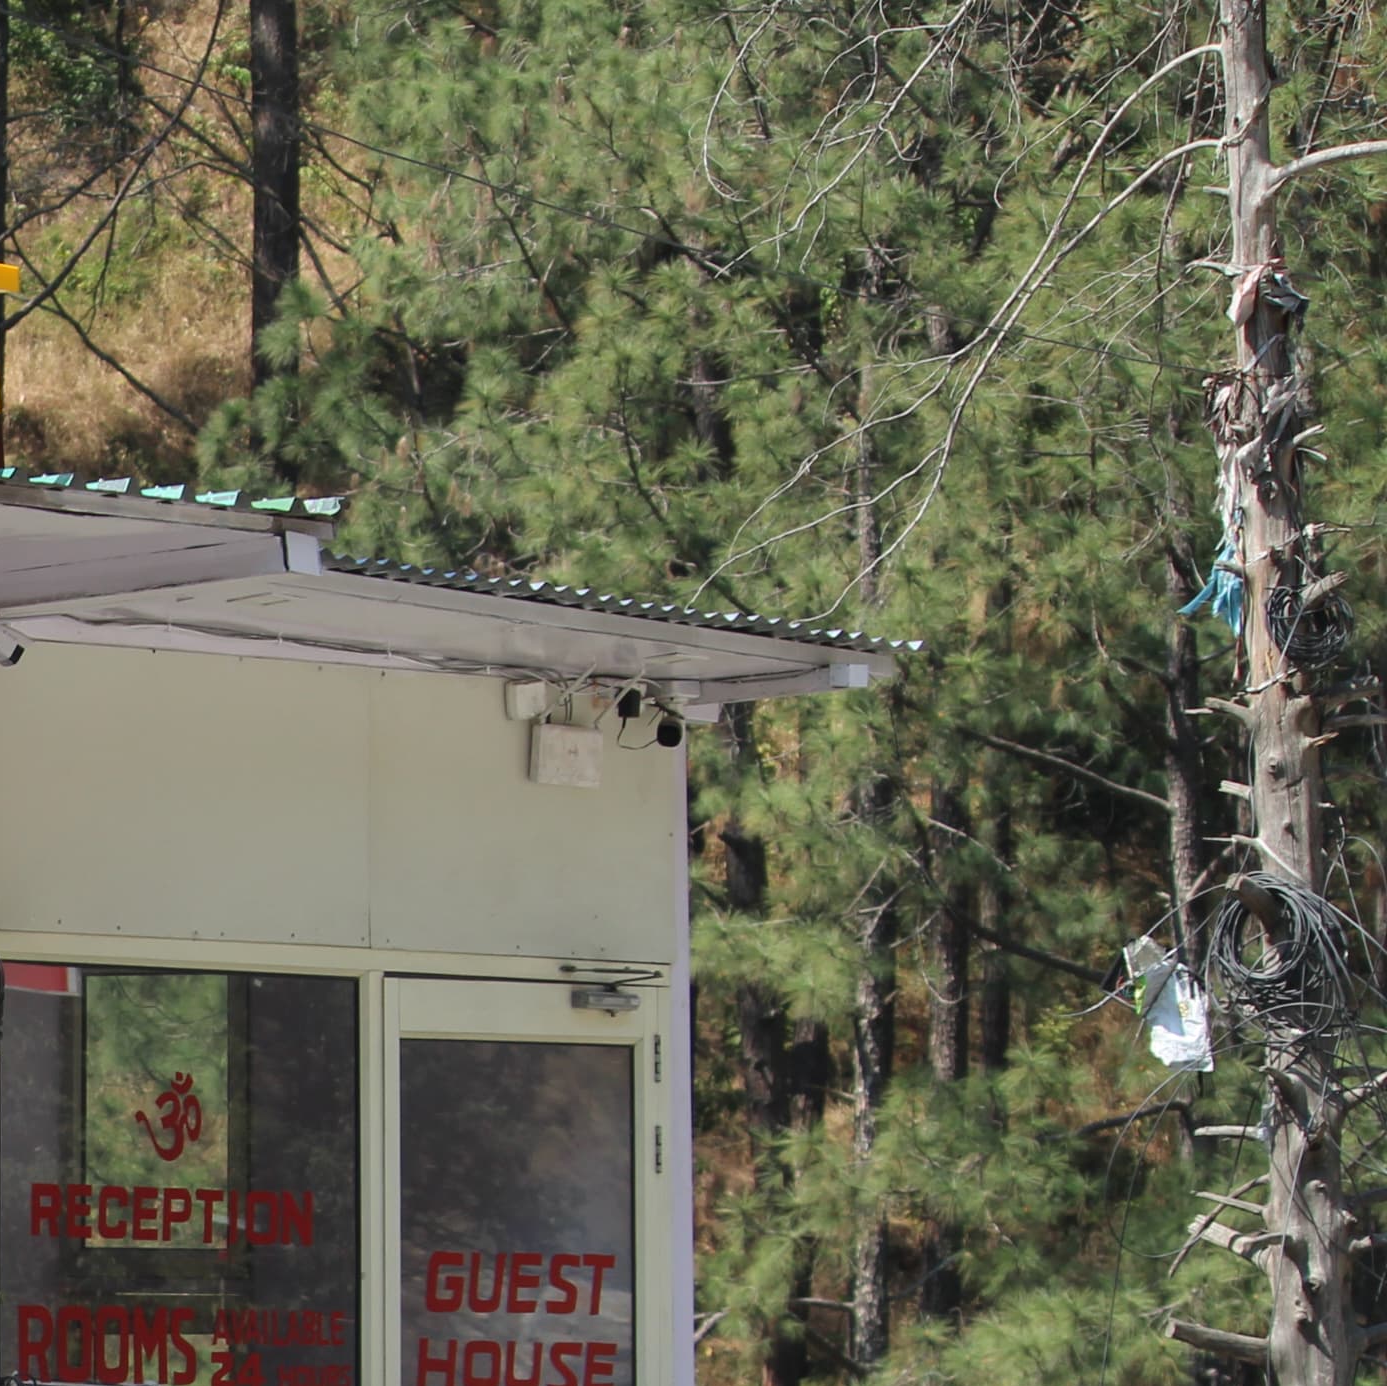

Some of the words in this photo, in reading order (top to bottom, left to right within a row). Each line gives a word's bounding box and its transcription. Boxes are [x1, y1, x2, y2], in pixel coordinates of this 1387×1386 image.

[30, 1183, 314, 1248] RECEPTION
[426, 1251, 616, 1316] GUEST
[17, 1304, 197, 1386] ROOMS
[211, 1308, 345, 1347] AVAILABLE
